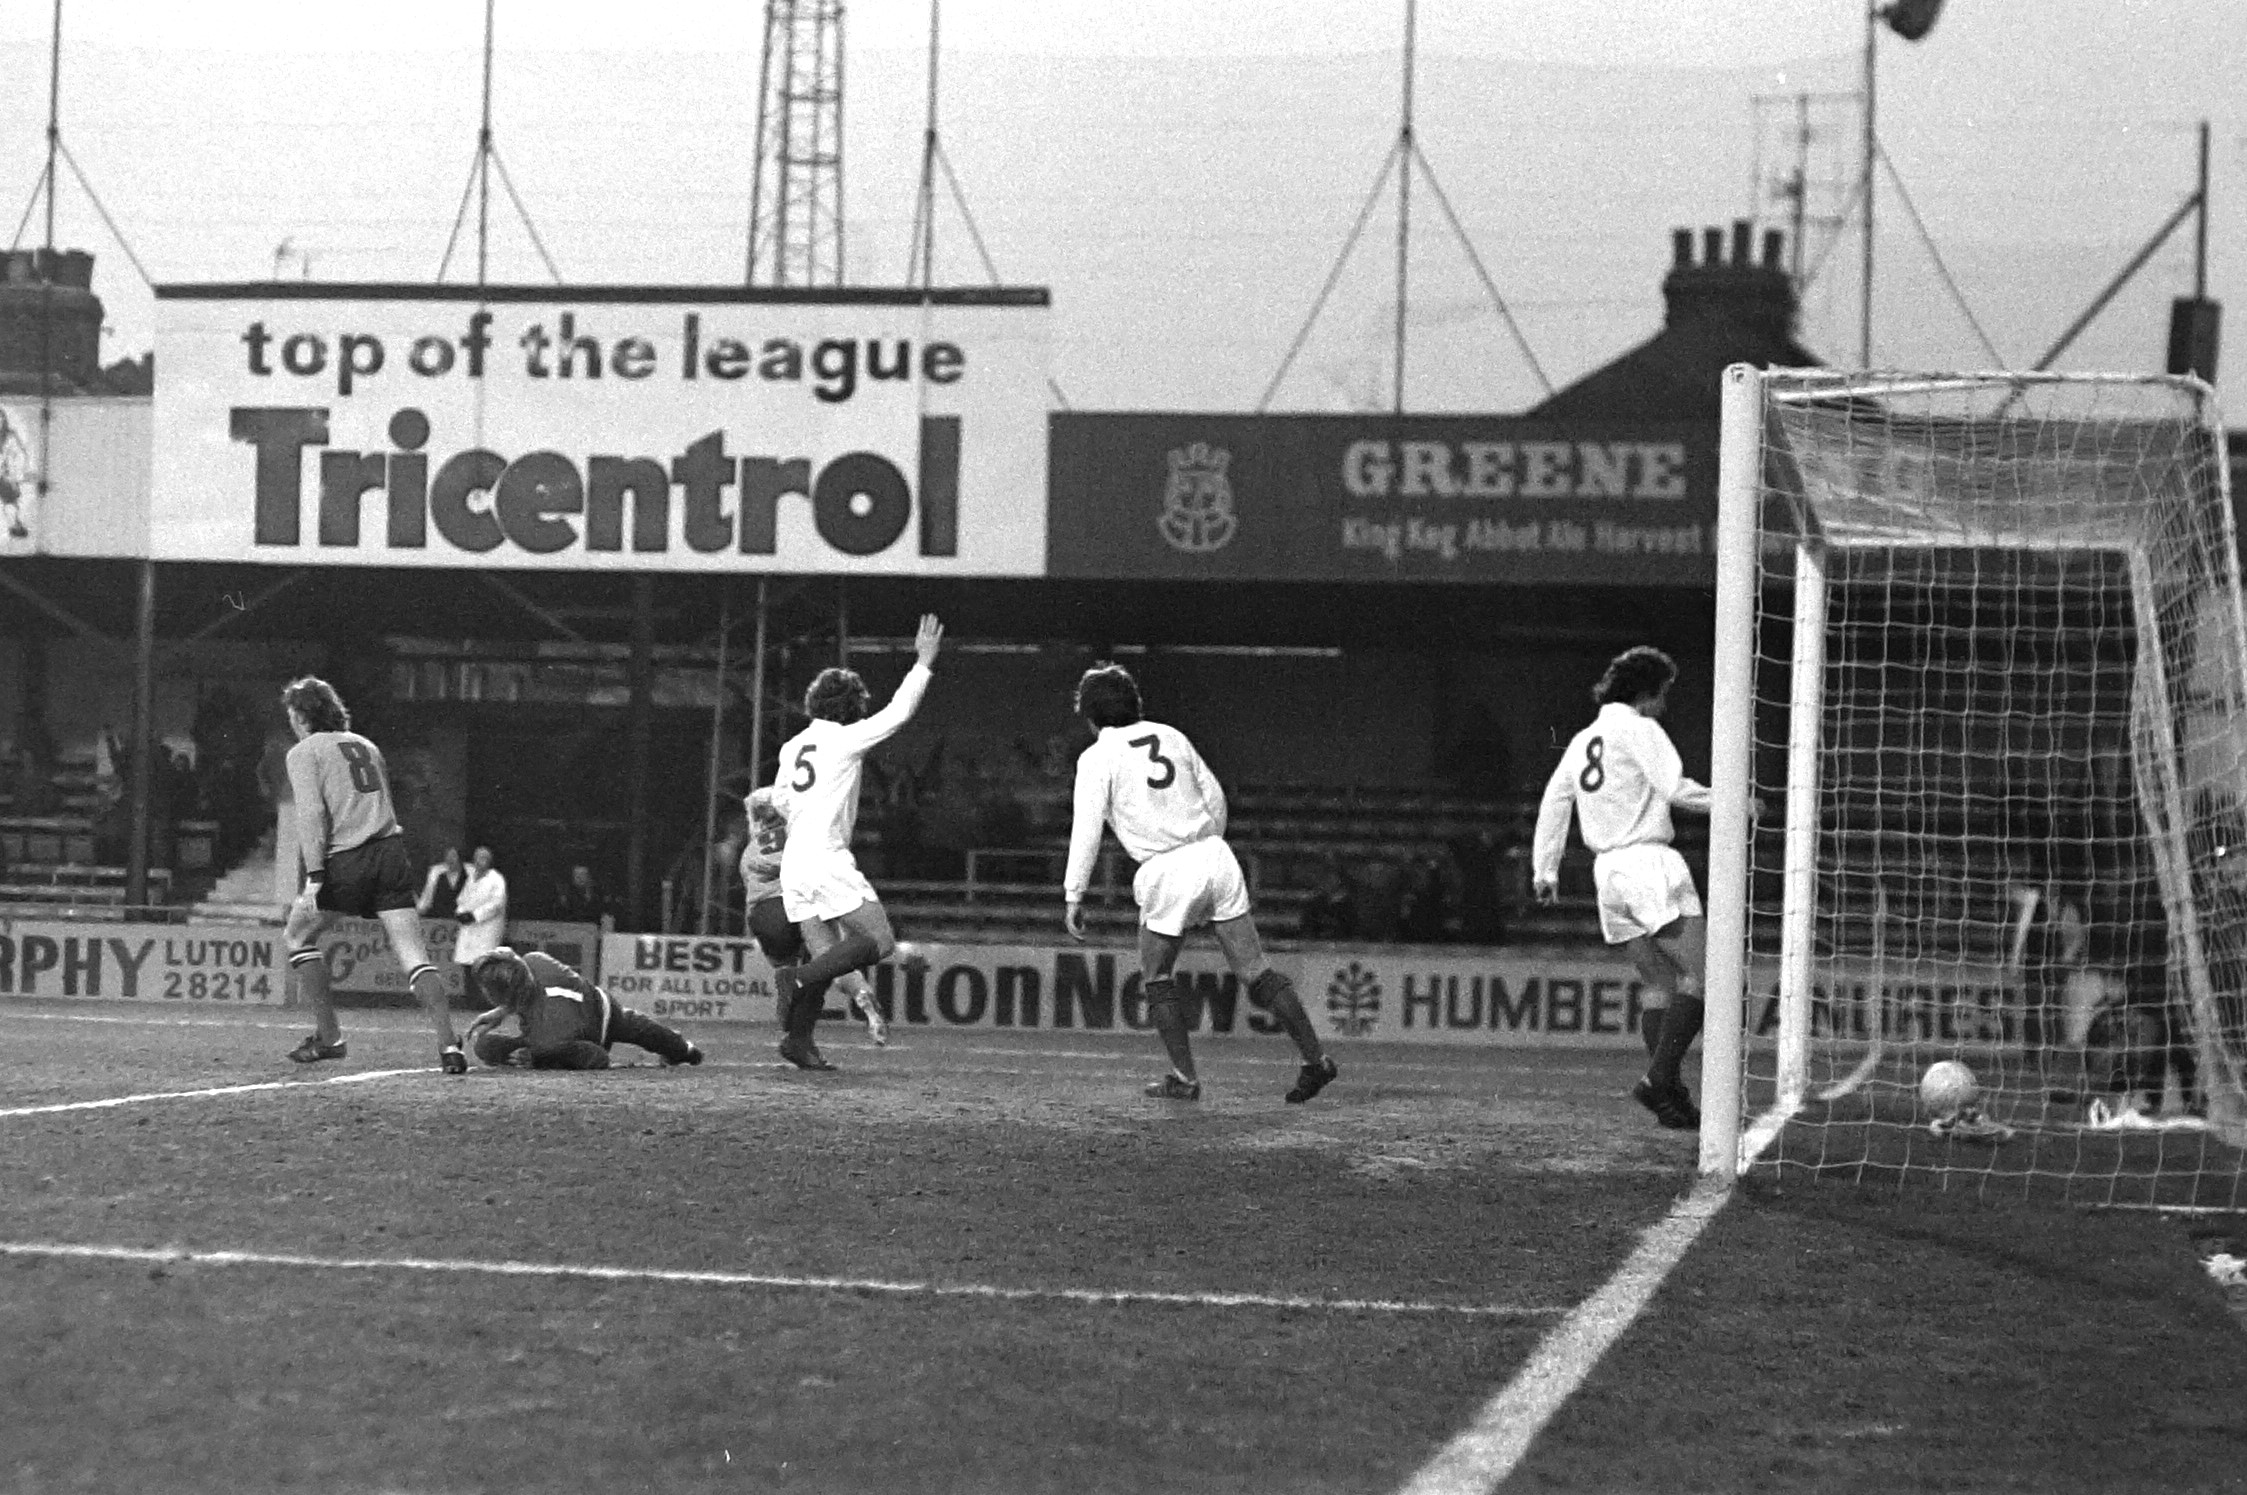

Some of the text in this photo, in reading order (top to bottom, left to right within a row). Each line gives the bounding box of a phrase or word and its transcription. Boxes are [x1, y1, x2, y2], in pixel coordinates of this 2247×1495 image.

[242, 313, 967, 402] top of the league
[229, 408, 963, 558] Tricentrol
[1342, 439, 1688, 499] GREENE
[337, 741, 382, 793] 8
[791, 743, 817, 793] 5
[1127, 733, 1176, 790] 3
[1580, 735, 1605, 793] 8
[164, 938, 273, 968] LUTON
[635, 938, 755, 975] BEST
[163, 971, 272, 1001] 28214
[606, 974, 774, 998] FOR ALL LOCAL
[653, 1000, 730, 1018] SPORT
[818, 952, 1041, 1028] uton
